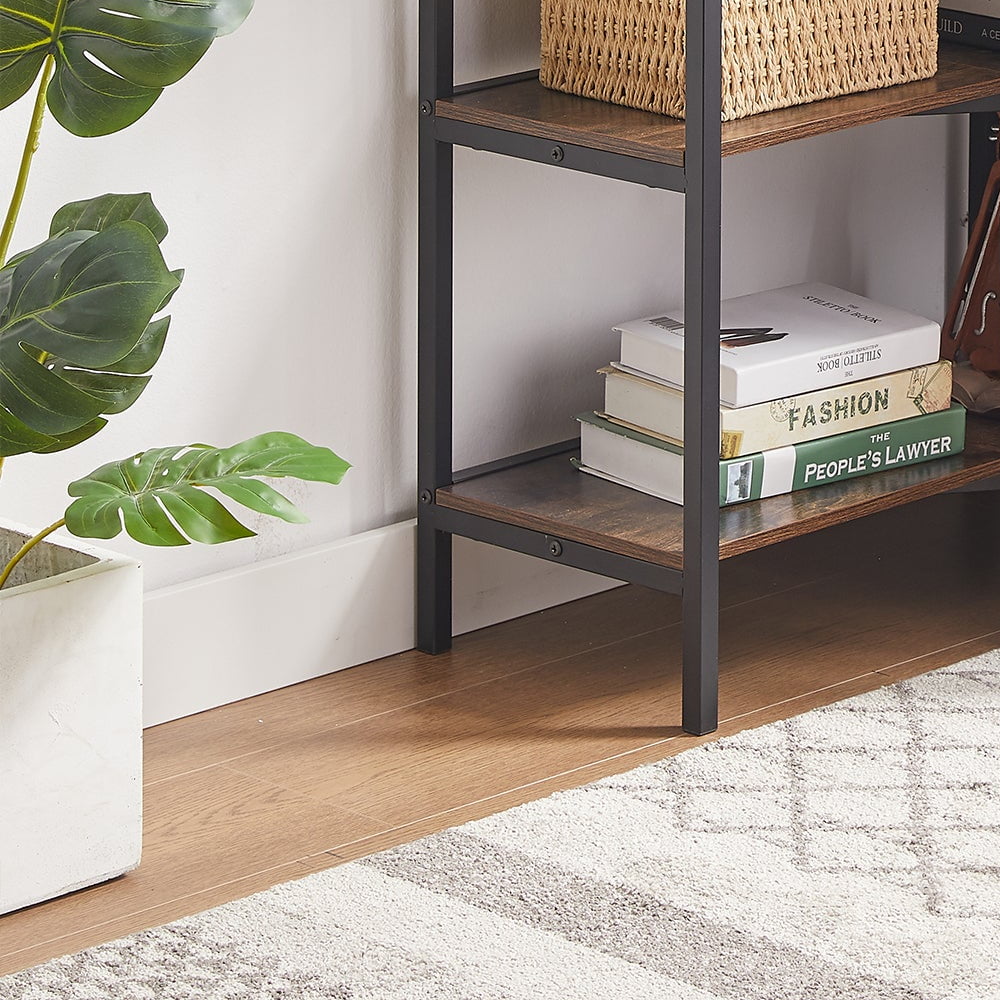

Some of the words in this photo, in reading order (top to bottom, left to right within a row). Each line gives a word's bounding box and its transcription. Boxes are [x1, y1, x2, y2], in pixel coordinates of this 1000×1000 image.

[981, 28, 988, 38] A
[803, 295, 851, 313] STILETTO
[817, 358, 840, 373] BOOK
[843, 348, 882, 367] STILETTO
[787, 388, 891, 432] FASHION
[870, 431, 891, 444] THE
[804, 449, 882, 483] PEOPLE'S
[885, 436, 952, 466] LAWYER
